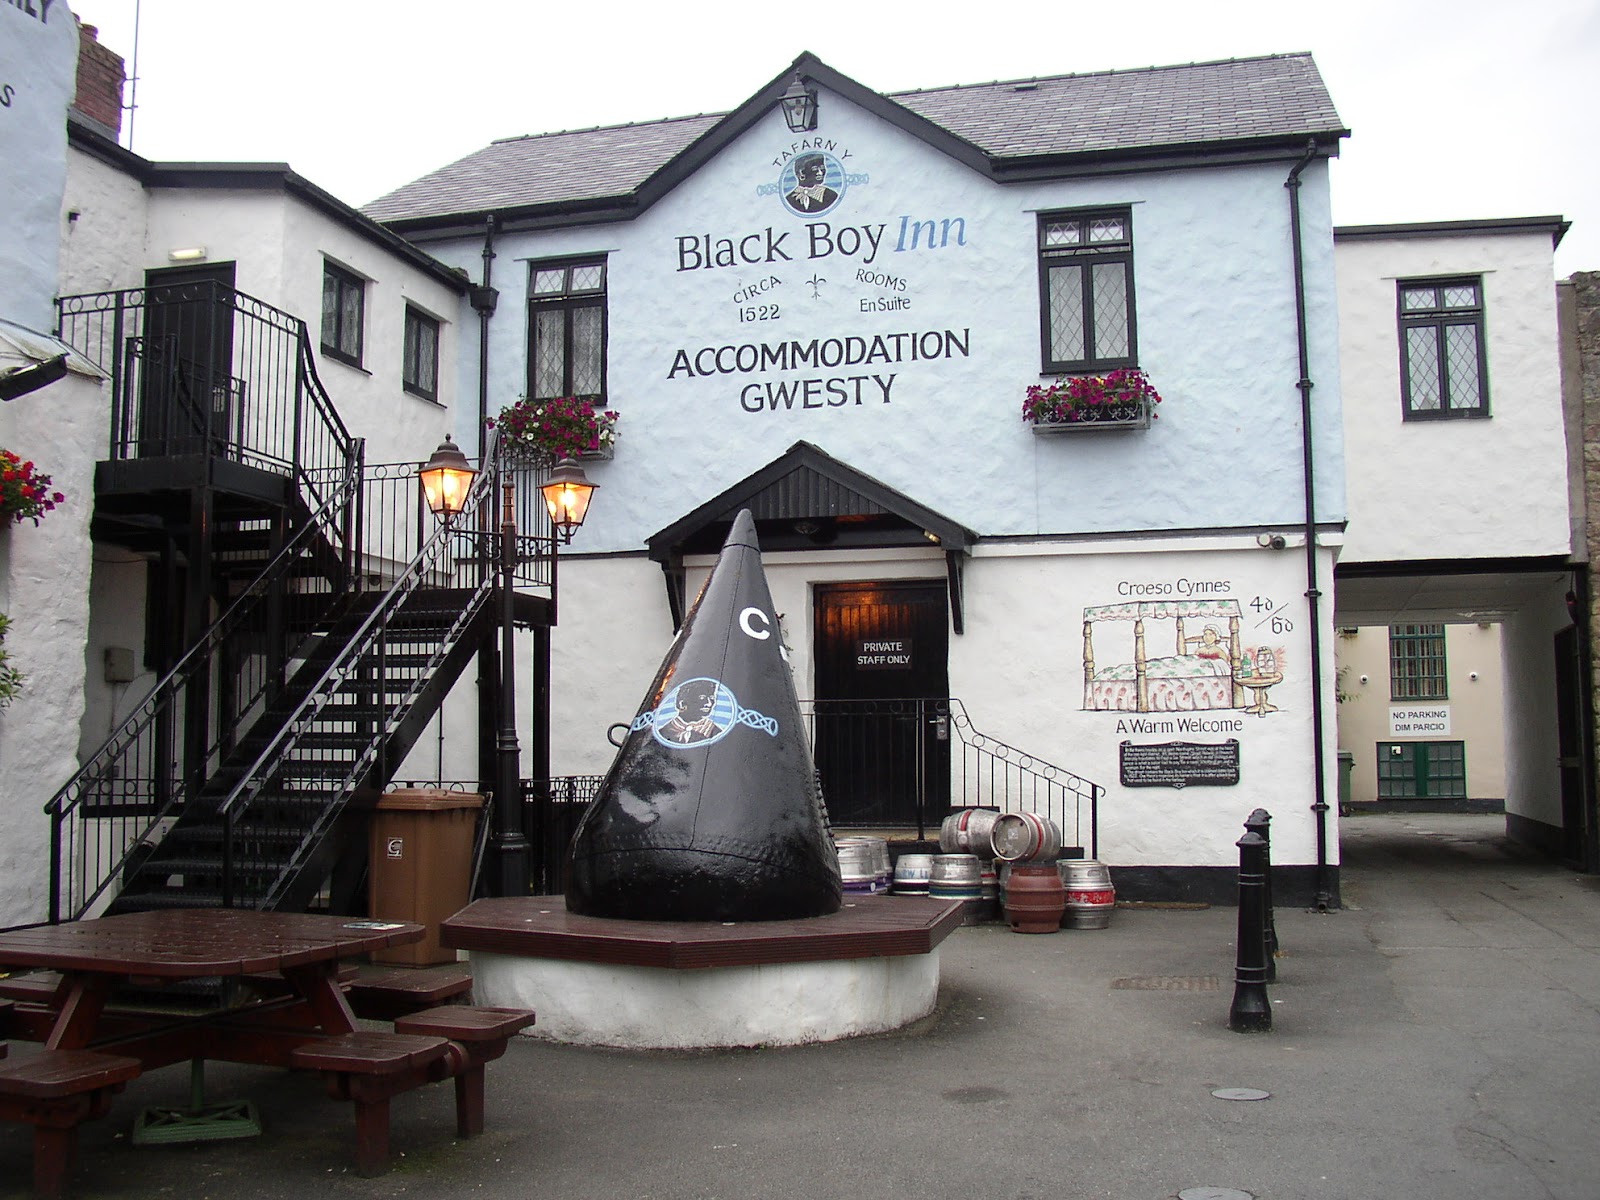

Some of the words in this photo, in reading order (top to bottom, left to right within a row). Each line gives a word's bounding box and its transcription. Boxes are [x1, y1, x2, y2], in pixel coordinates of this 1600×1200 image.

[772, 136, 838, 167] TAFARN
[841, 149, 853, 160] Y
[674, 227, 794, 272] Black
[805, 222, 887, 264] Boy
[894, 215, 967, 252] Inn
[733, 275, 782, 304] CIRCA
[855, 268, 907, 292] ROOMS
[739, 303, 781, 323] 1522
[666, 328, 970, 380] ACCOMMODATION
[740, 373, 898, 413] GWESTY
[1117, 581, 1173, 596] Croeso
[1176, 578, 1231, 598] Cynnes
[863, 642, 903, 652] PRIVATE
[857, 655, 886, 665] STAFF
[887, 655, 910, 665] ONLY
[1392, 711, 1405, 719] NO
[1408, 710, 1447, 719] PARKING
[1116, 719, 1128, 734] A
[1129, 719, 1174, 734] Warm
[1177, 718, 1243, 733] Welcome
[1394, 724, 1411, 732] DIM
[1413, 723, 1445, 731] PARCIO
